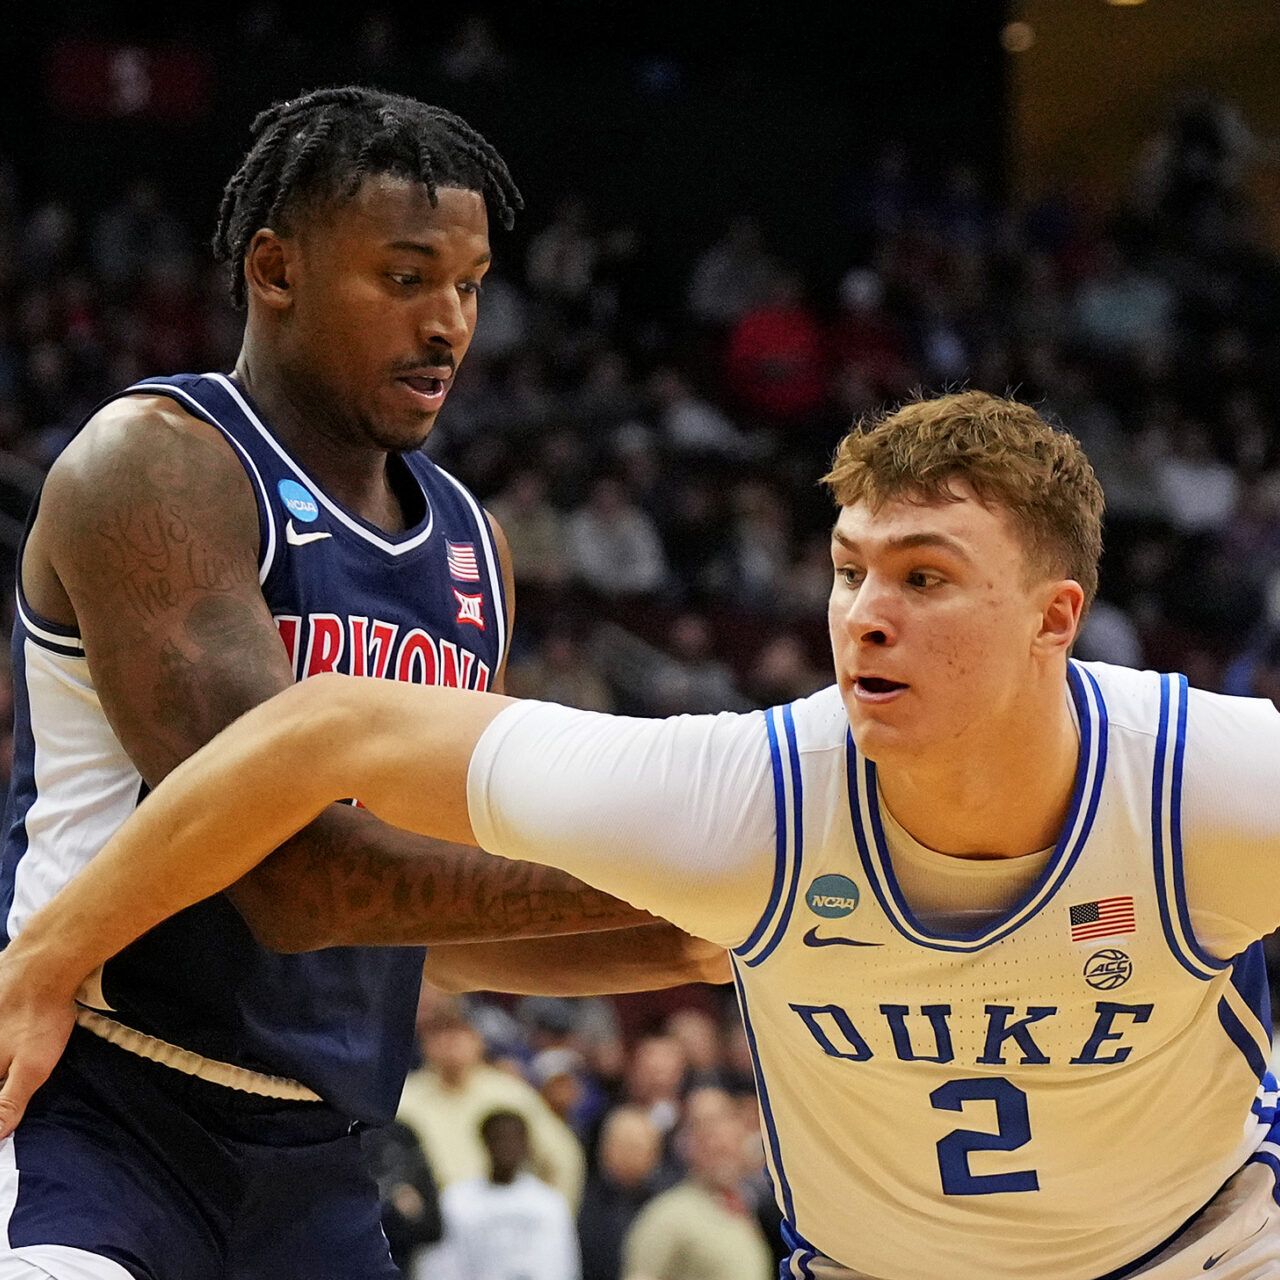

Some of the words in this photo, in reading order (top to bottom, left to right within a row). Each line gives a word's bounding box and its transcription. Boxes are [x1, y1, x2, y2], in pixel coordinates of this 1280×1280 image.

[812, 895, 855, 910] NCAA
[788, 1001, 1155, 1065] DUKE
[929, 1076, 1040, 1196] 2
